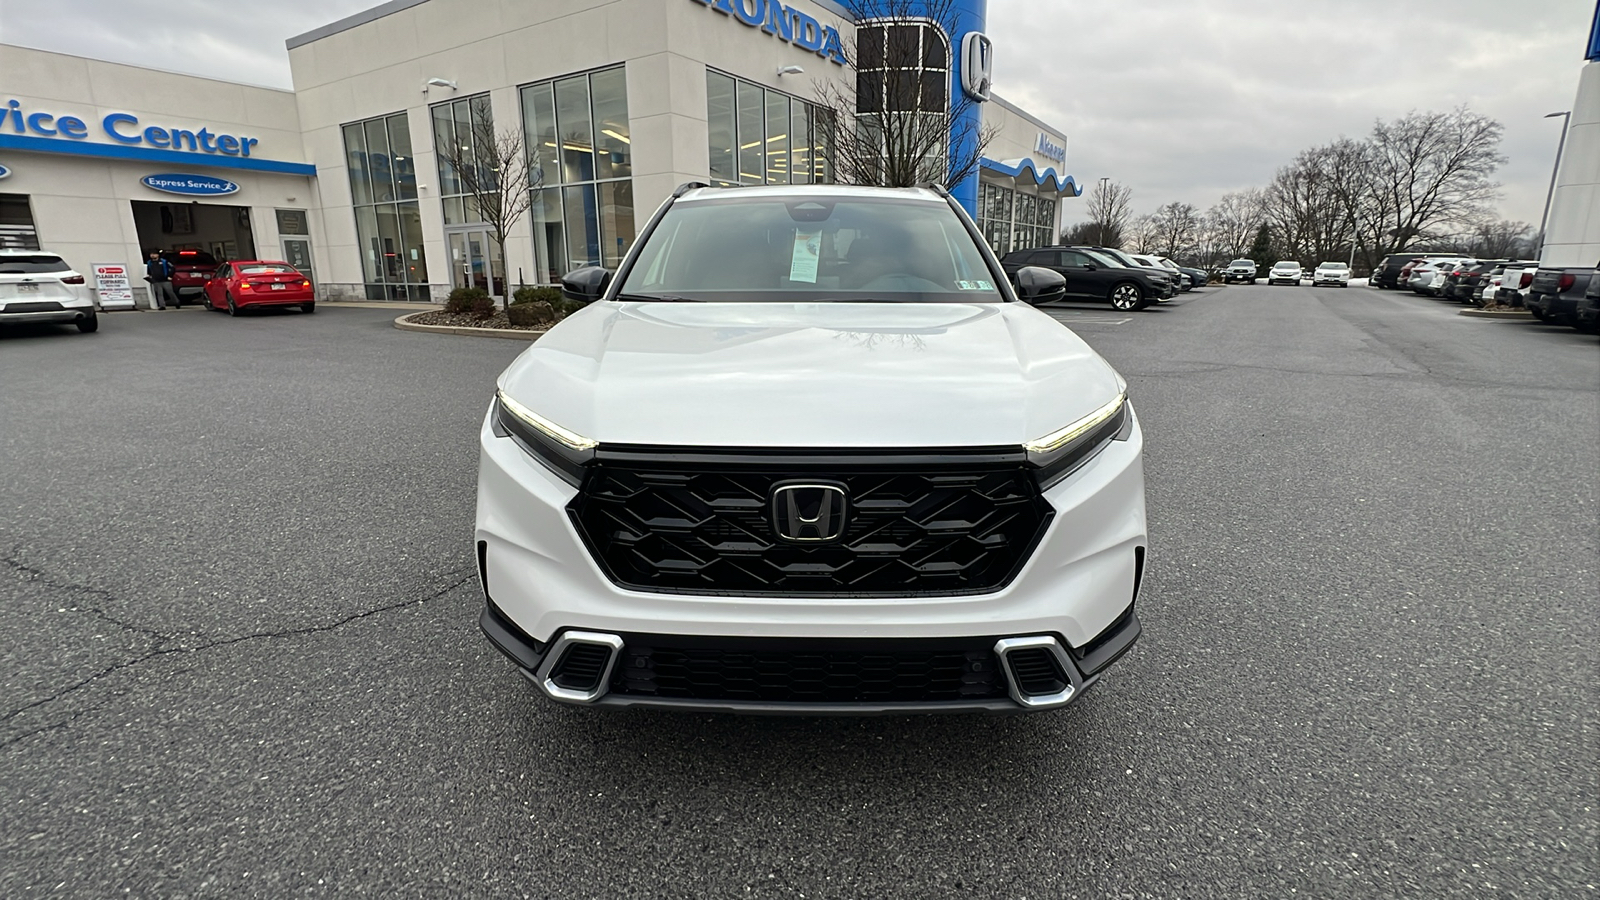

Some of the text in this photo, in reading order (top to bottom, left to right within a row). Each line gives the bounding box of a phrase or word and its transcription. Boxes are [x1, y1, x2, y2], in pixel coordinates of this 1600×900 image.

[692, 0, 847, 66] ONDA
[102, 112, 259, 157] Center
[148, 177, 221, 190] Express Service
